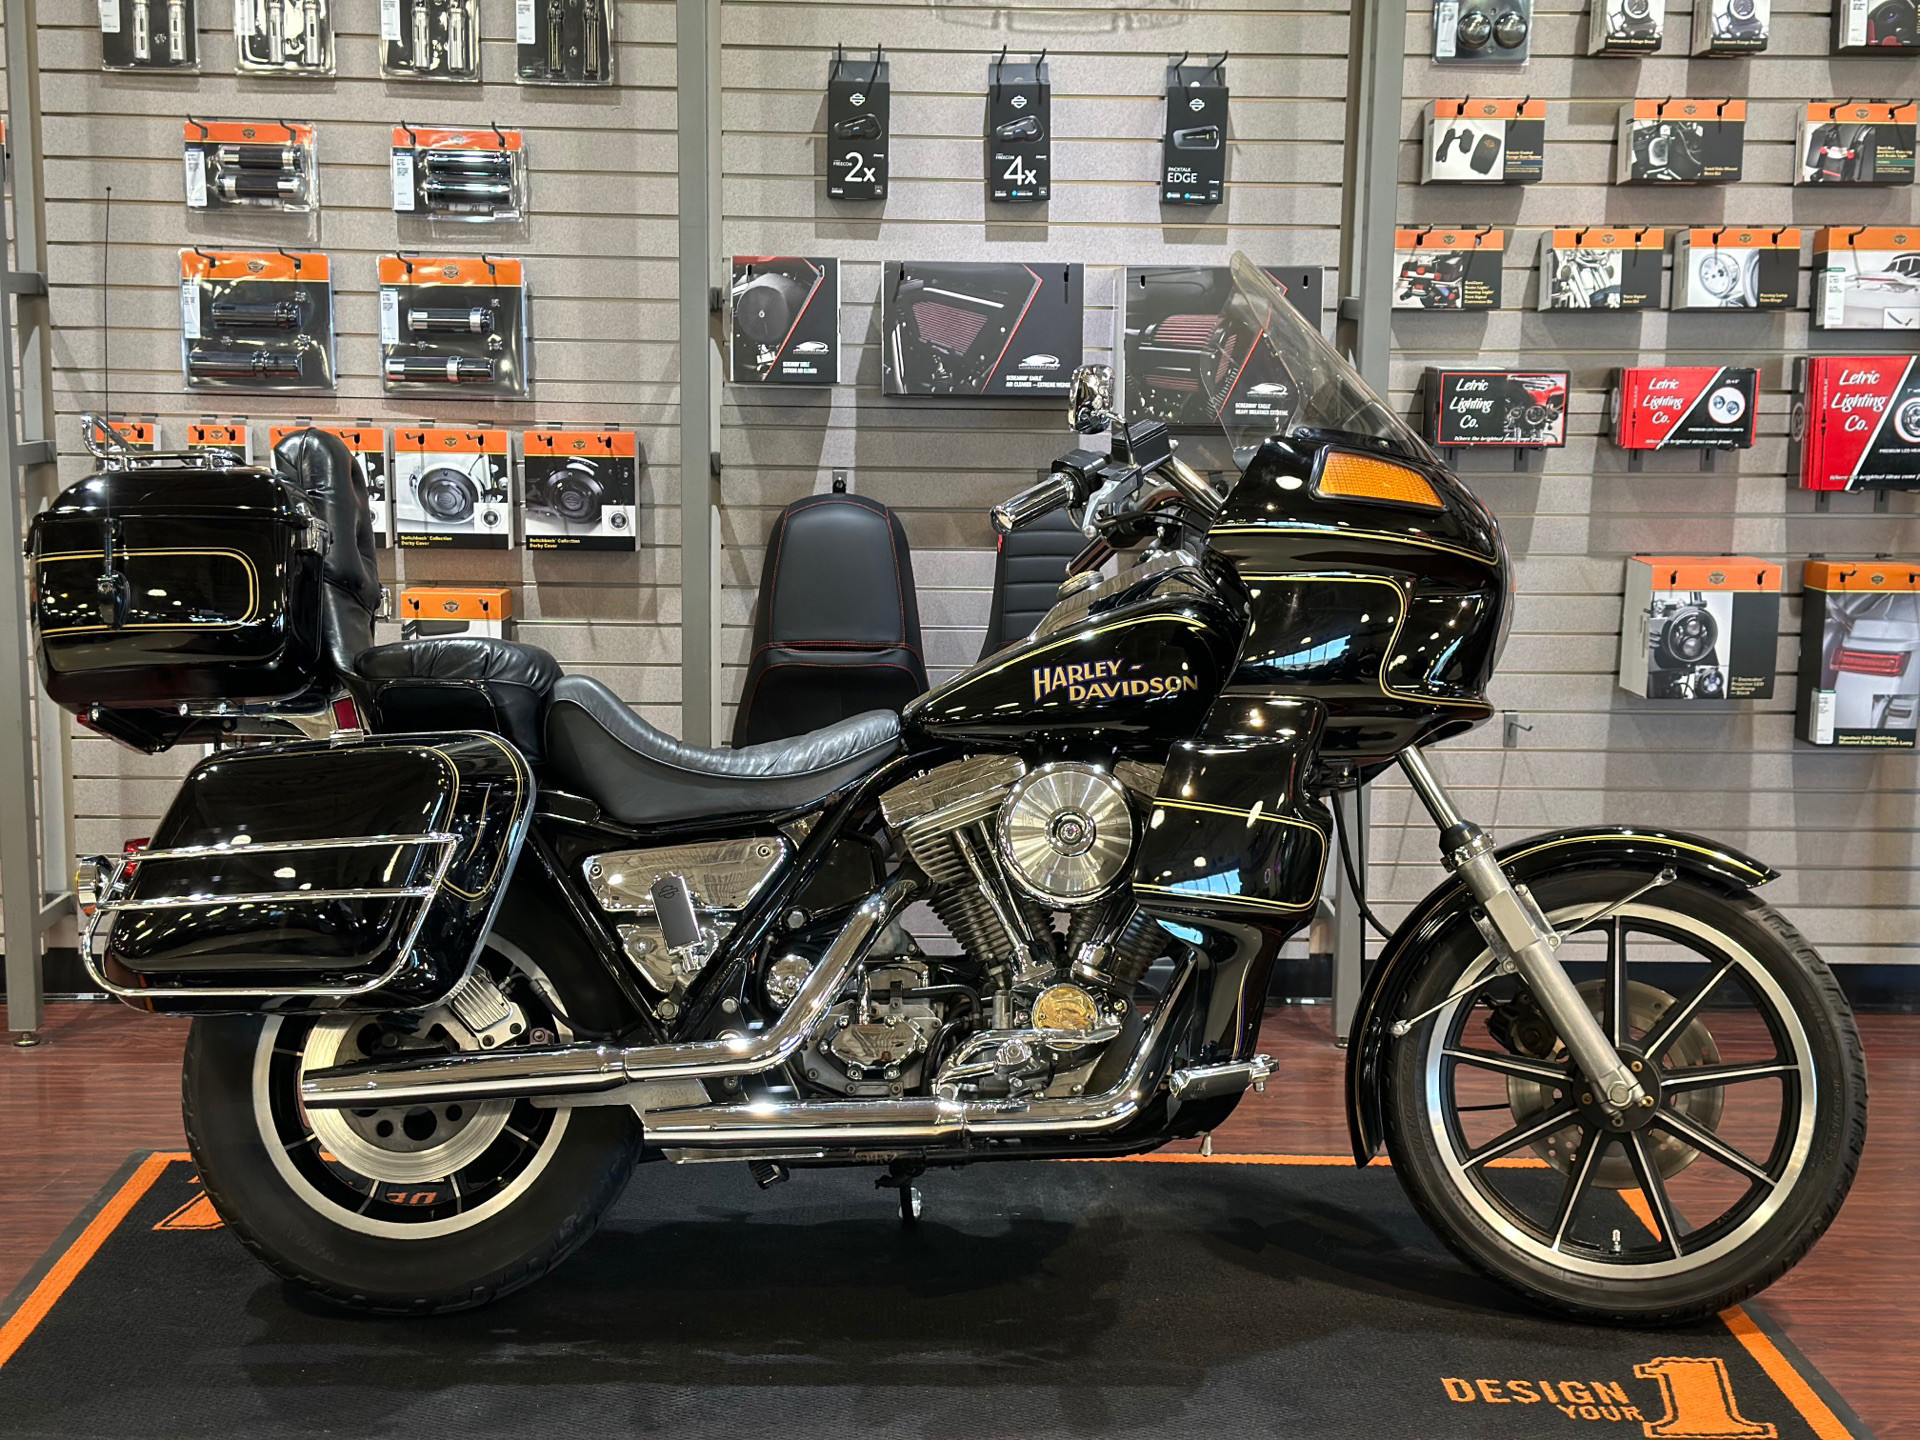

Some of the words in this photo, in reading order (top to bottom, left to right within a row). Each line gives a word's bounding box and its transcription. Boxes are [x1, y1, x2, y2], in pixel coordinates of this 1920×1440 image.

[844, 152, 876, 182] 2x
[1003, 155, 1037, 185] 4x
[1167, 172, 1198, 183] EDGE
[1456, 378, 1489, 391] Letric
[1648, 378, 1679, 390] Letric
[1838, 369, 1880, 386] Letric
[1449, 396, 1494, 413] Lighting
[1642, 394, 1684, 410] Lighting
[1830, 392, 1888, 413] Lighting
[1460, 414, 1479, 428] Co.
[1652, 411, 1670, 424] Co.
[1844, 414, 1868, 432] Co.
[1069, 675, 1198, 702] DAVIDSON
[1440, 1377, 1630, 1404] DESIGN
[1556, 1404, 1646, 1422] YOUR
